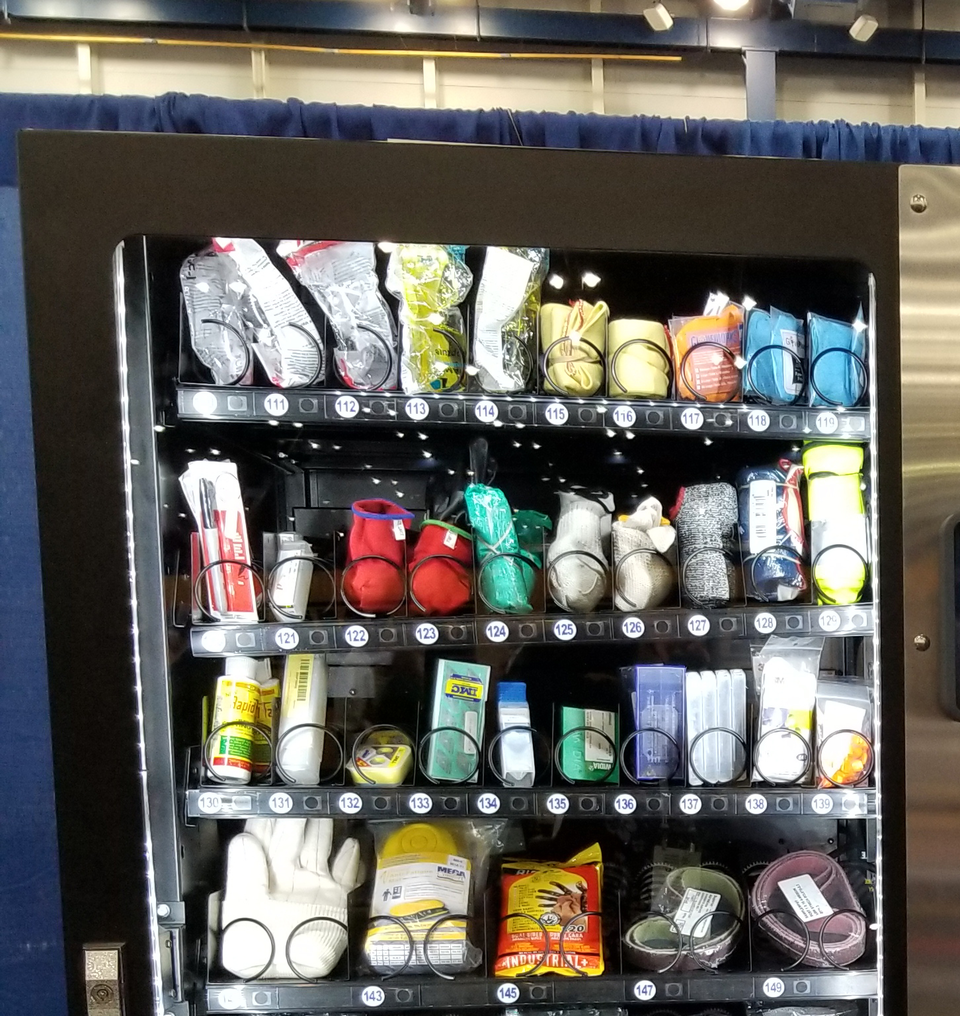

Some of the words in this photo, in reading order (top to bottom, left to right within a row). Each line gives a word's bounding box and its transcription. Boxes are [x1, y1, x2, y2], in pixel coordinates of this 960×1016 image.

[267, 399, 284, 410] 111
[337, 401, 356, 412] 112
[407, 403, 425, 414] 113
[476, 405, 494, 417] 114
[546, 408, 565, 420] 115
[682, 413, 699, 424] 117
[748, 415, 766, 426] 118
[623, 622, 641, 633] 126
[689, 620, 706, 631] 127
[755, 617, 773, 628] 128
[417, 628, 436, 639] 123
[487, 626, 506, 637] 124
[555, 624, 573, 635] 125
[277, 632, 295, 644] 121
[346, 630, 366, 641] 122
[271, 797, 289, 808] 131
[340, 797, 360, 808] 132
[410, 798, 429, 809] 133
[479, 798, 497, 809] 134
[548, 798, 566, 809] 135
[615, 799, 634, 810] 136
[681, 799, 700, 810] 137
[747, 799, 766, 810] 138
[437, 865, 466, 879] MEGA
[635, 985, 653, 996] 147
[765, 982, 782, 993] 149
[363, 991, 382, 1002] 143
[499, 988, 517, 999] 145
